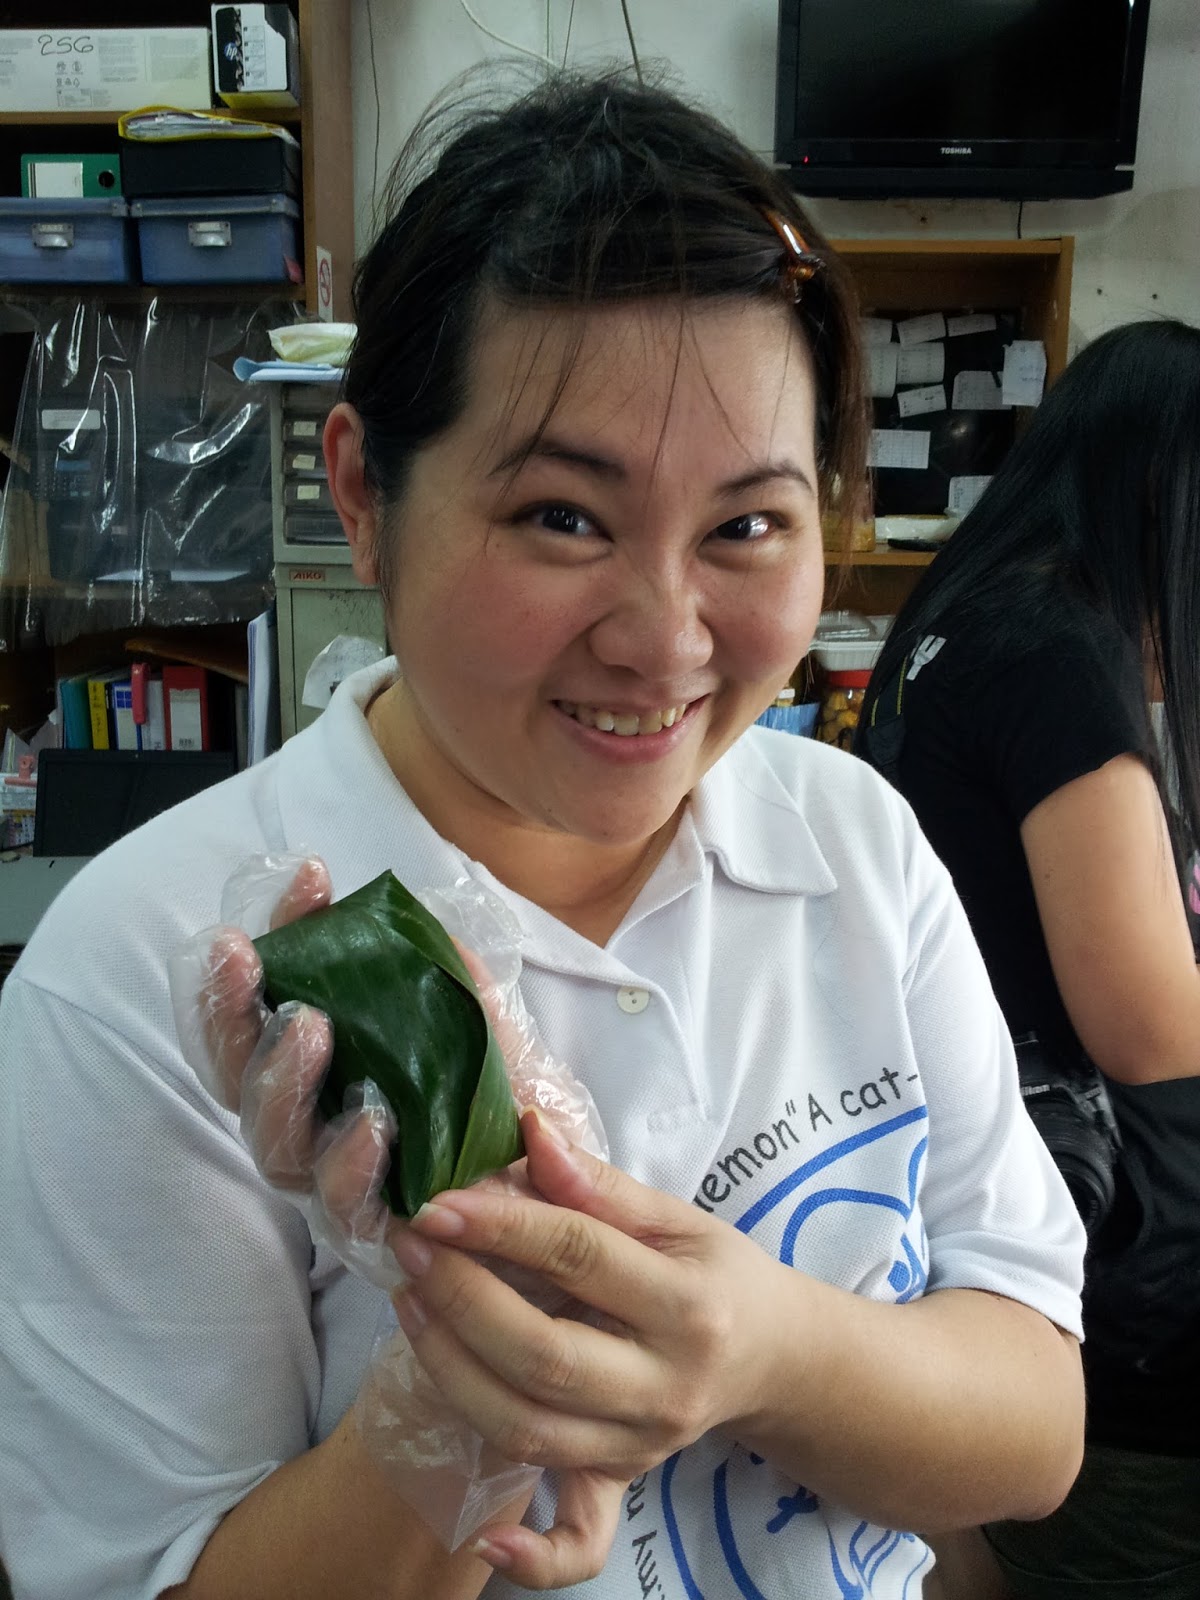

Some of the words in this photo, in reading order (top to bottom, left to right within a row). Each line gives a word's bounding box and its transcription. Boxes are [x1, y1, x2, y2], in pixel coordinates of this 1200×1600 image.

[225, 42, 239, 61] hp
[940, 147, 973, 155] TOSHIBA
[293, 571, 322, 581] AIKO
[808, 1092, 833, 1132] A
